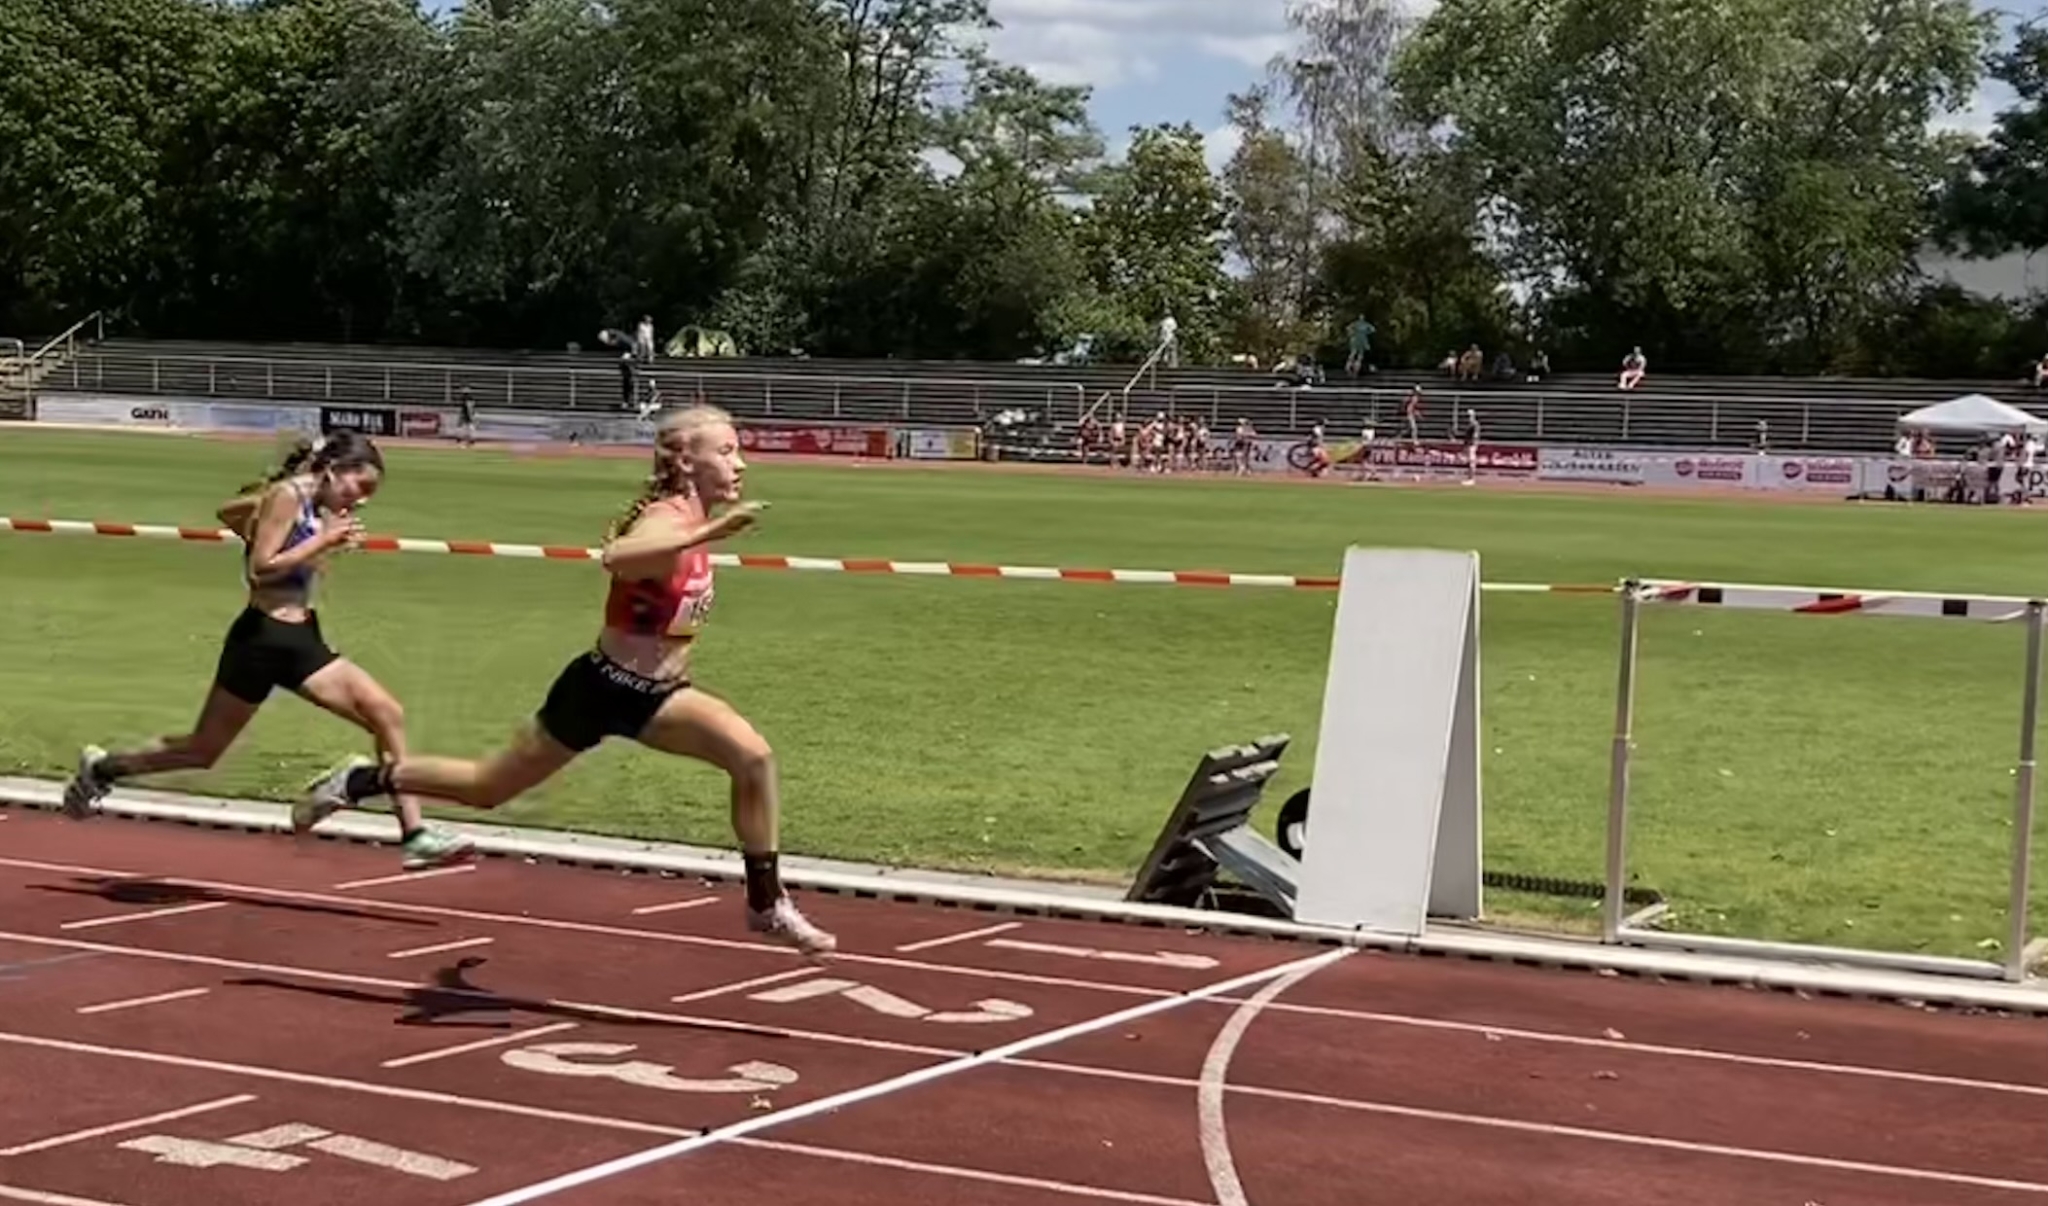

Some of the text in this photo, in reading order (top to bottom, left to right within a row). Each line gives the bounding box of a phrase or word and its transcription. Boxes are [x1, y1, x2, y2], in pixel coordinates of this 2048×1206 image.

[600, 663, 652, 693] NIKE
[746, 978, 1034, 1023] 2
[500, 1042, 799, 1092] 3
[115, 1122, 479, 1181] 4
